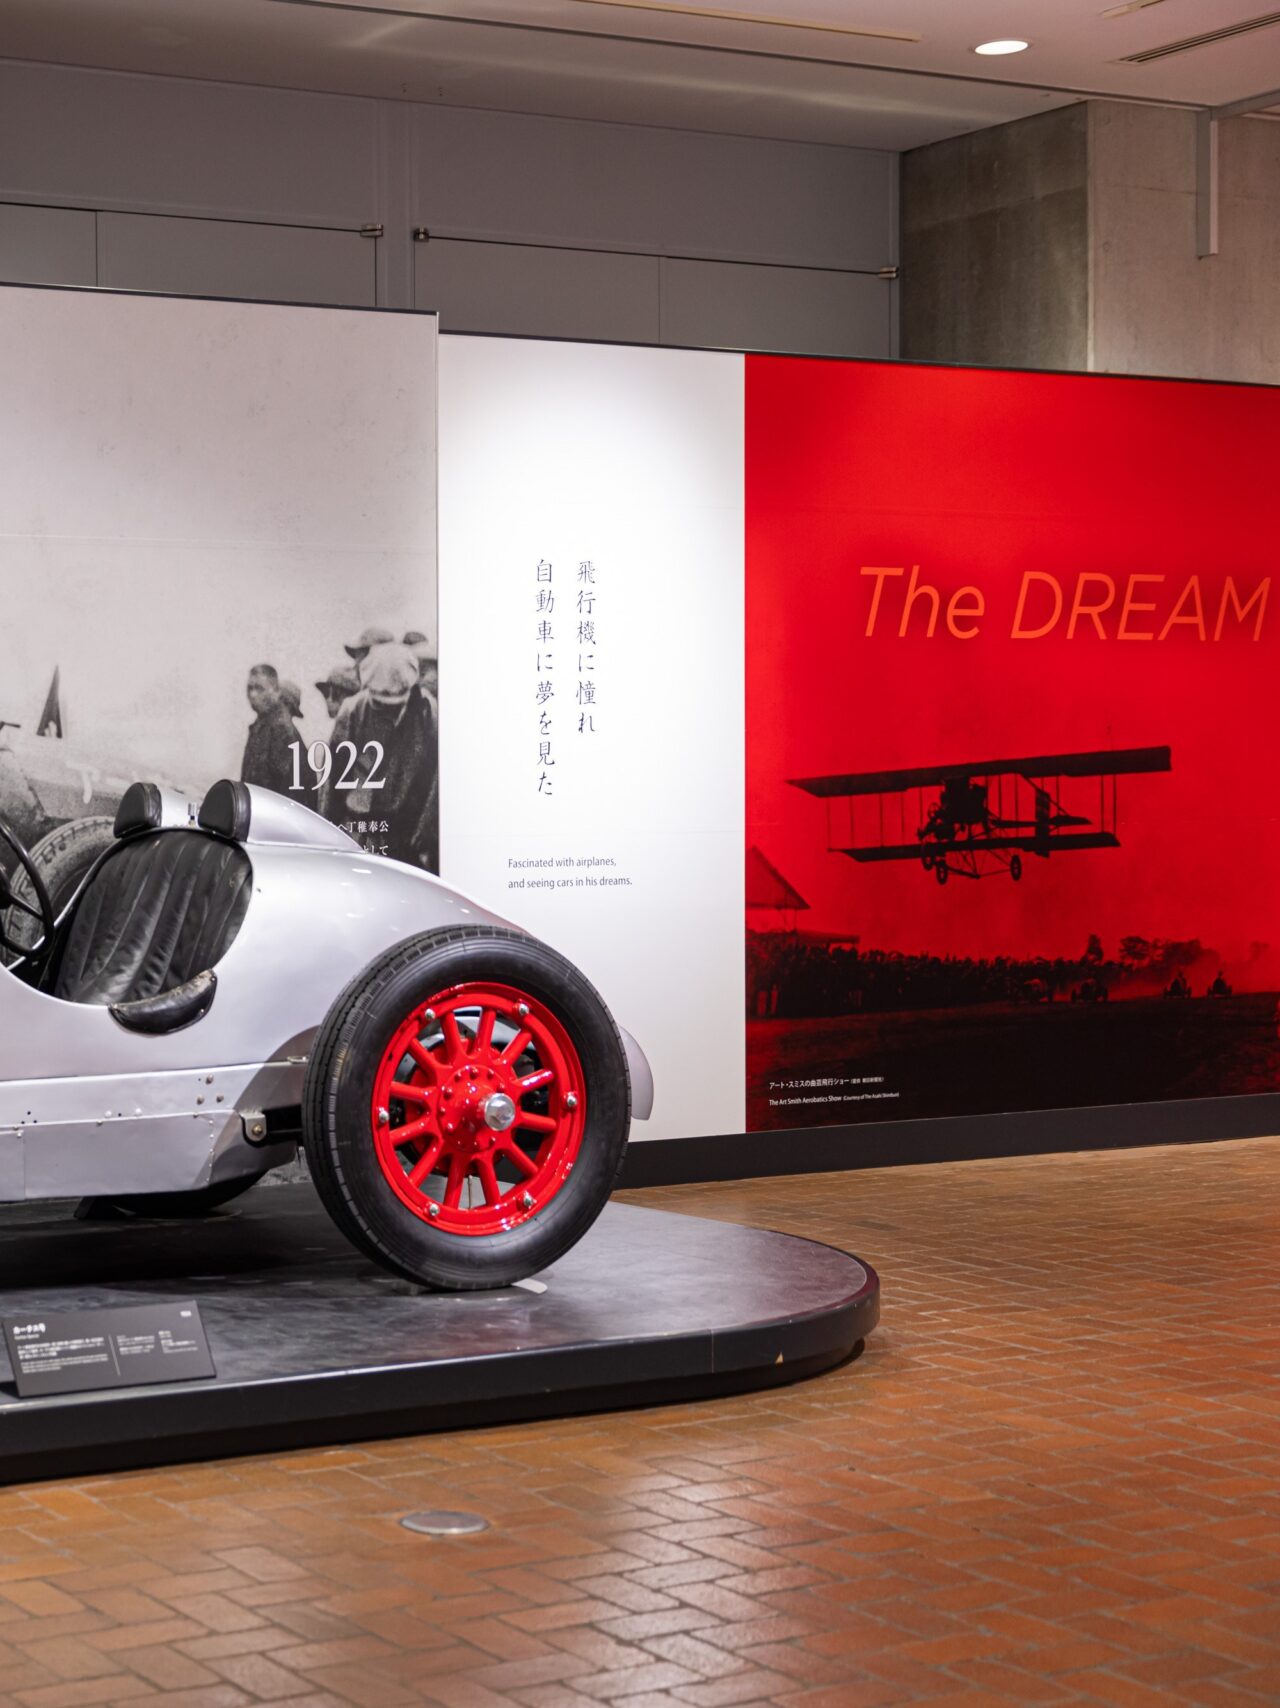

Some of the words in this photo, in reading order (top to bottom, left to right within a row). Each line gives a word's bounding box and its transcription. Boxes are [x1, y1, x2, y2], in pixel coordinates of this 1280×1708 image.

[859, 564, 985, 639] The
[1010, 570, 1272, 642] DREAM
[575, 559, 597, 734] 飛行機に憧れ
[535, 558, 556, 796] 自動車に夢を見た
[287, 740, 387, 791] 1922
[507, 858, 554, 869] Fascinated
[556, 857, 574, 868] with
[576, 856, 617, 869] airplanes,
[508, 878, 525, 889] and
[526, 878, 555, 890] seeing
[557, 878, 574, 888] cars
[575, 877, 584, 887] in
[585, 876, 598, 887] his
[599, 876, 633, 887] dreams.
[769, 1099, 779, 1107] The
